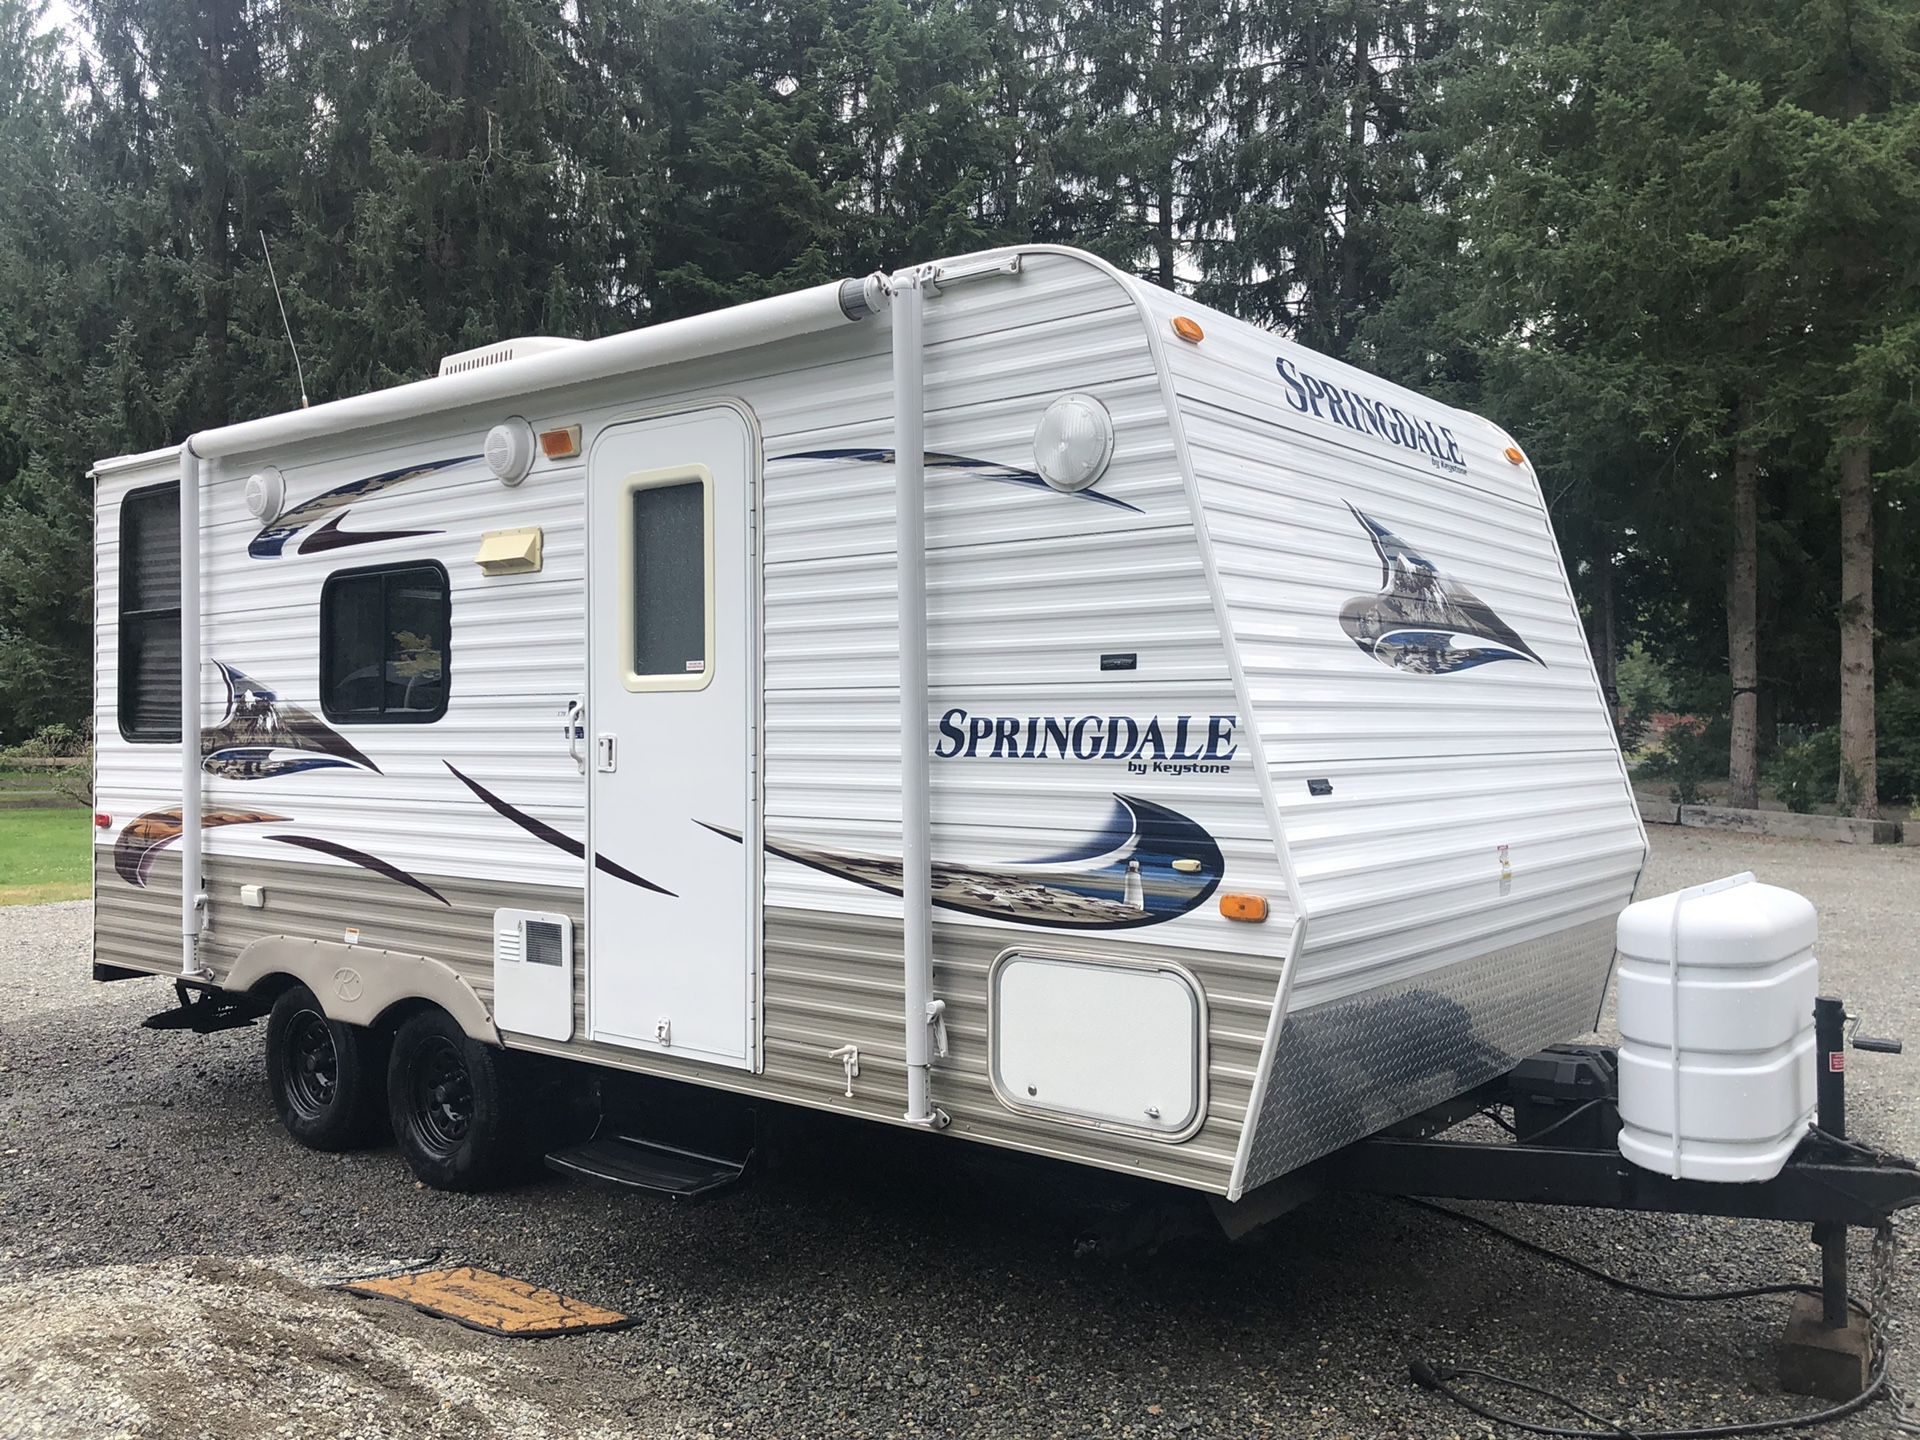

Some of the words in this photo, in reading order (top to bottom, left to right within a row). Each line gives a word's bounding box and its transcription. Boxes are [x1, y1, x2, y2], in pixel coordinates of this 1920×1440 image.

[1275, 356, 1467, 467] SPRINGDALE
[1431, 457, 1440, 469] by
[1441, 460, 1467, 475] Keystone
[934, 708, 1238, 760] SPRINGDALE
[1128, 761, 1147, 775] by
[1152, 761, 1230, 776] Keystone
